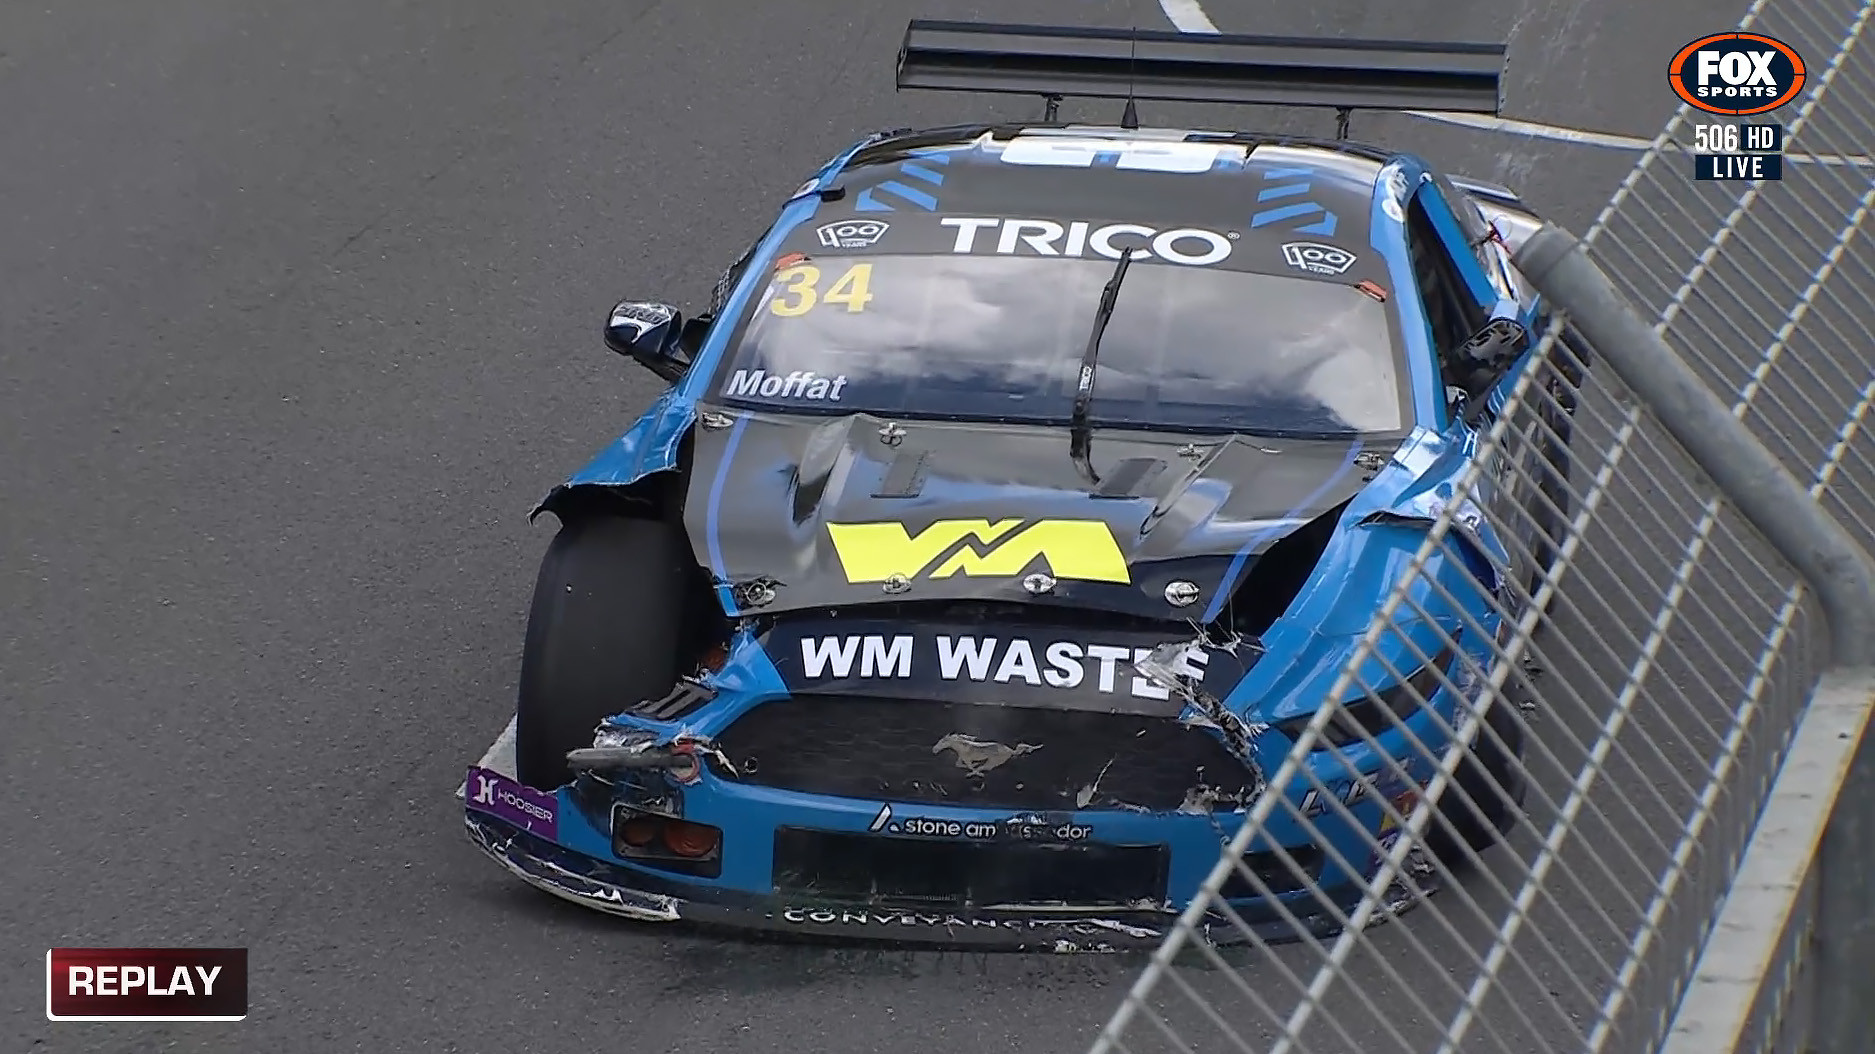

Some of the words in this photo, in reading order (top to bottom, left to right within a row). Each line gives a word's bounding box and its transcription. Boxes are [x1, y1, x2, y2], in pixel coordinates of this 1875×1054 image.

[826, 225, 880, 248] 100
[1291, 246, 1347, 270] 100
[769, 263, 874, 316] 34
[726, 368, 848, 401] Moffat
[801, 635, 914, 679] WM
[497, 788, 553, 823] HOOSIER
[905, 818, 961, 836] stone
